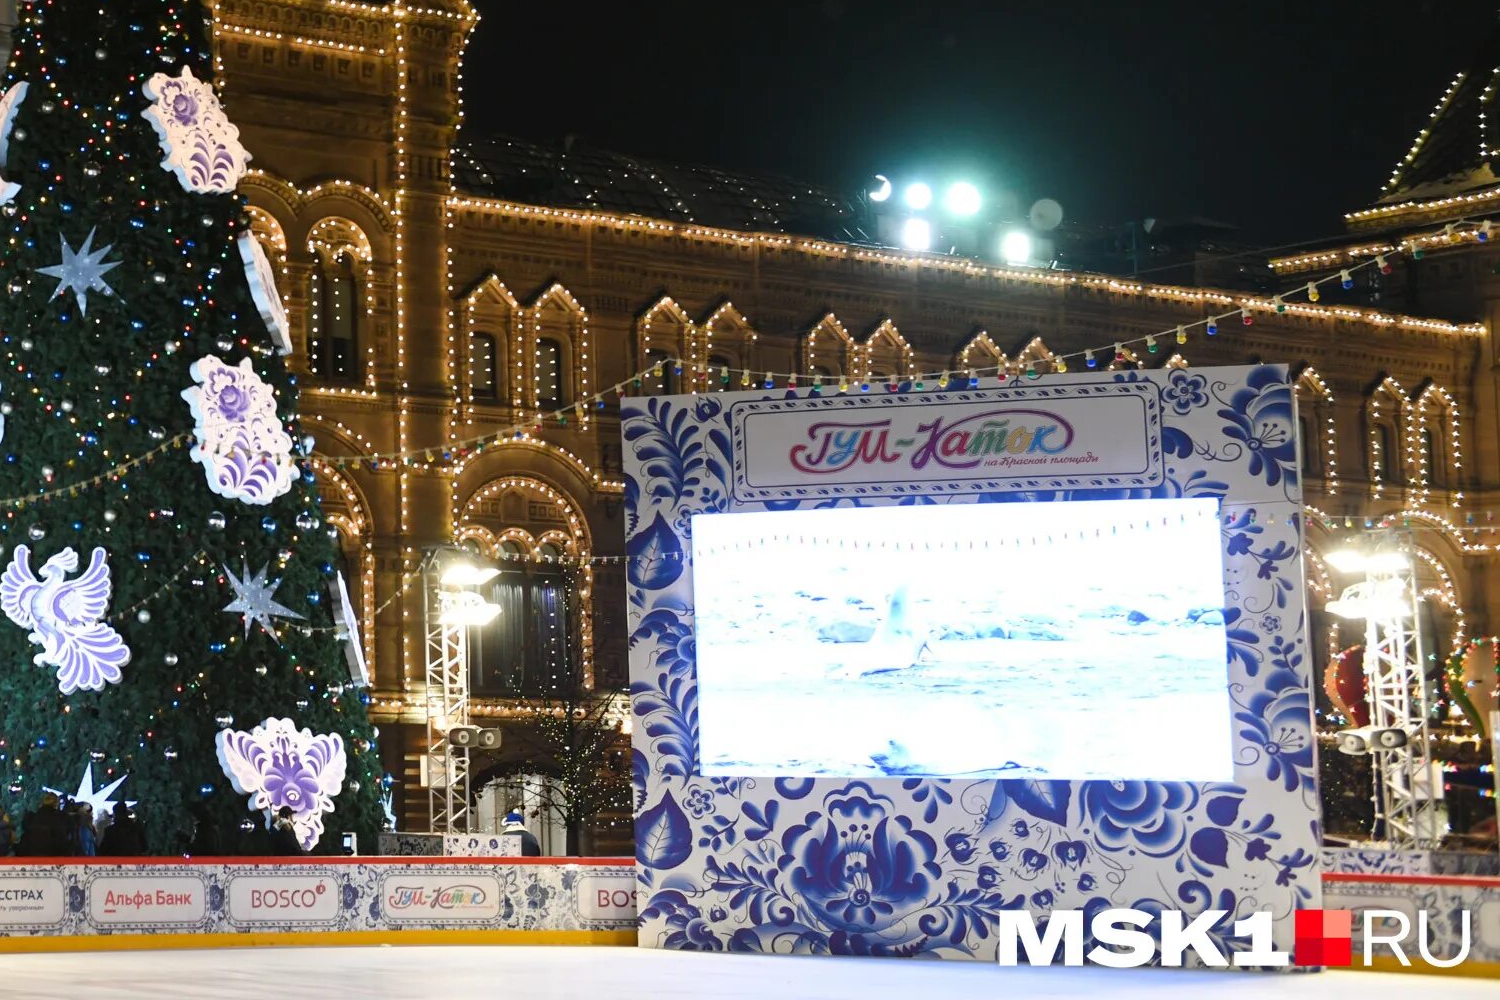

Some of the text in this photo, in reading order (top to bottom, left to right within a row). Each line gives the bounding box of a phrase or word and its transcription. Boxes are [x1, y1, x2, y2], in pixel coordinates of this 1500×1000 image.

[1000, 456, 1047, 468] Красной
[1050, 451, 1099, 464] площади
[105, 890, 192, 909] Альфа Банк
[252, 890, 316, 908] BOSCO
